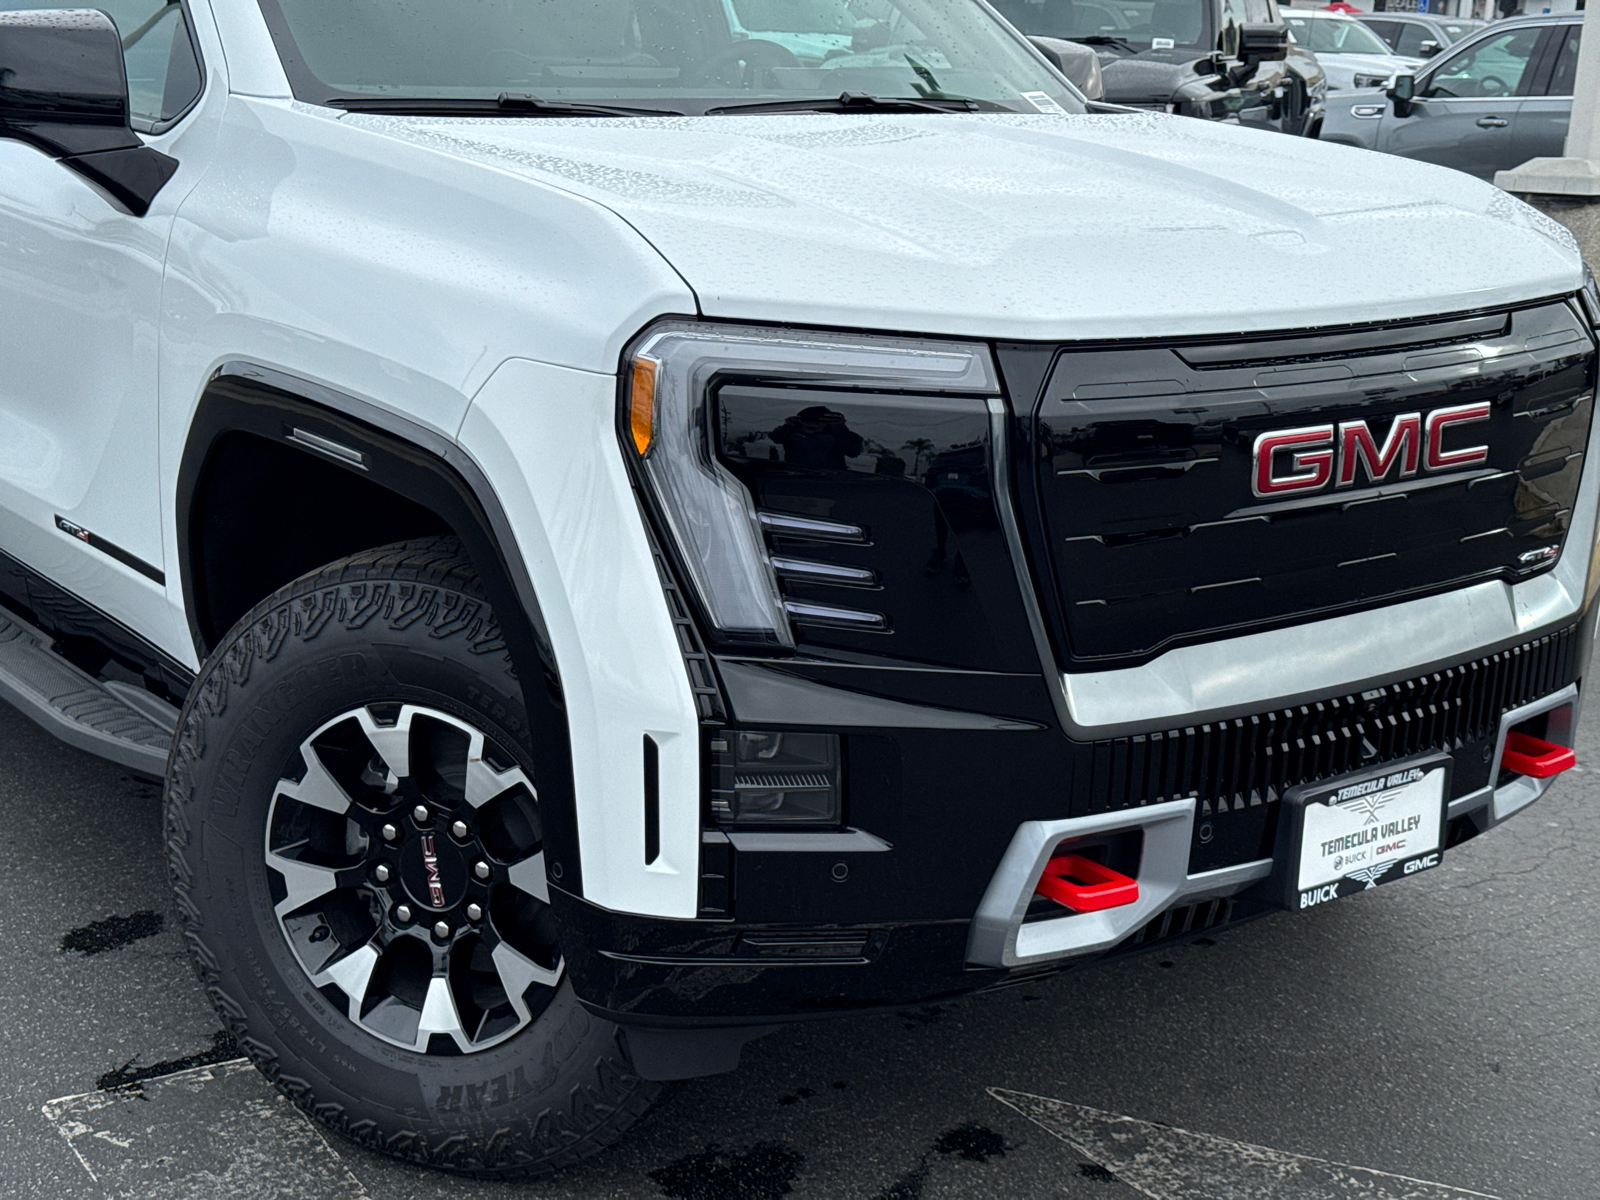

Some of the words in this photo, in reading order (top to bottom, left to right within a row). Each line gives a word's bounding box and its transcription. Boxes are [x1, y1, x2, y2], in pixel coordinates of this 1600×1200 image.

[1251, 400, 1491, 498] GMC
[211, 652, 368, 818] WRANGLER
[1337, 778, 1385, 801] TEMECULA
[1387, 768, 1420, 788] VALLEY
[1321, 826, 1378, 857] TEMECULA
[1380, 814, 1421, 838] VALLEY
[1345, 850, 1366, 865] BUICK
[1376, 839, 1406, 855] GMC
[420, 835, 446, 908] GMC
[1403, 853, 1439, 874] GMC
[1300, 882, 1339, 909] BUICK
